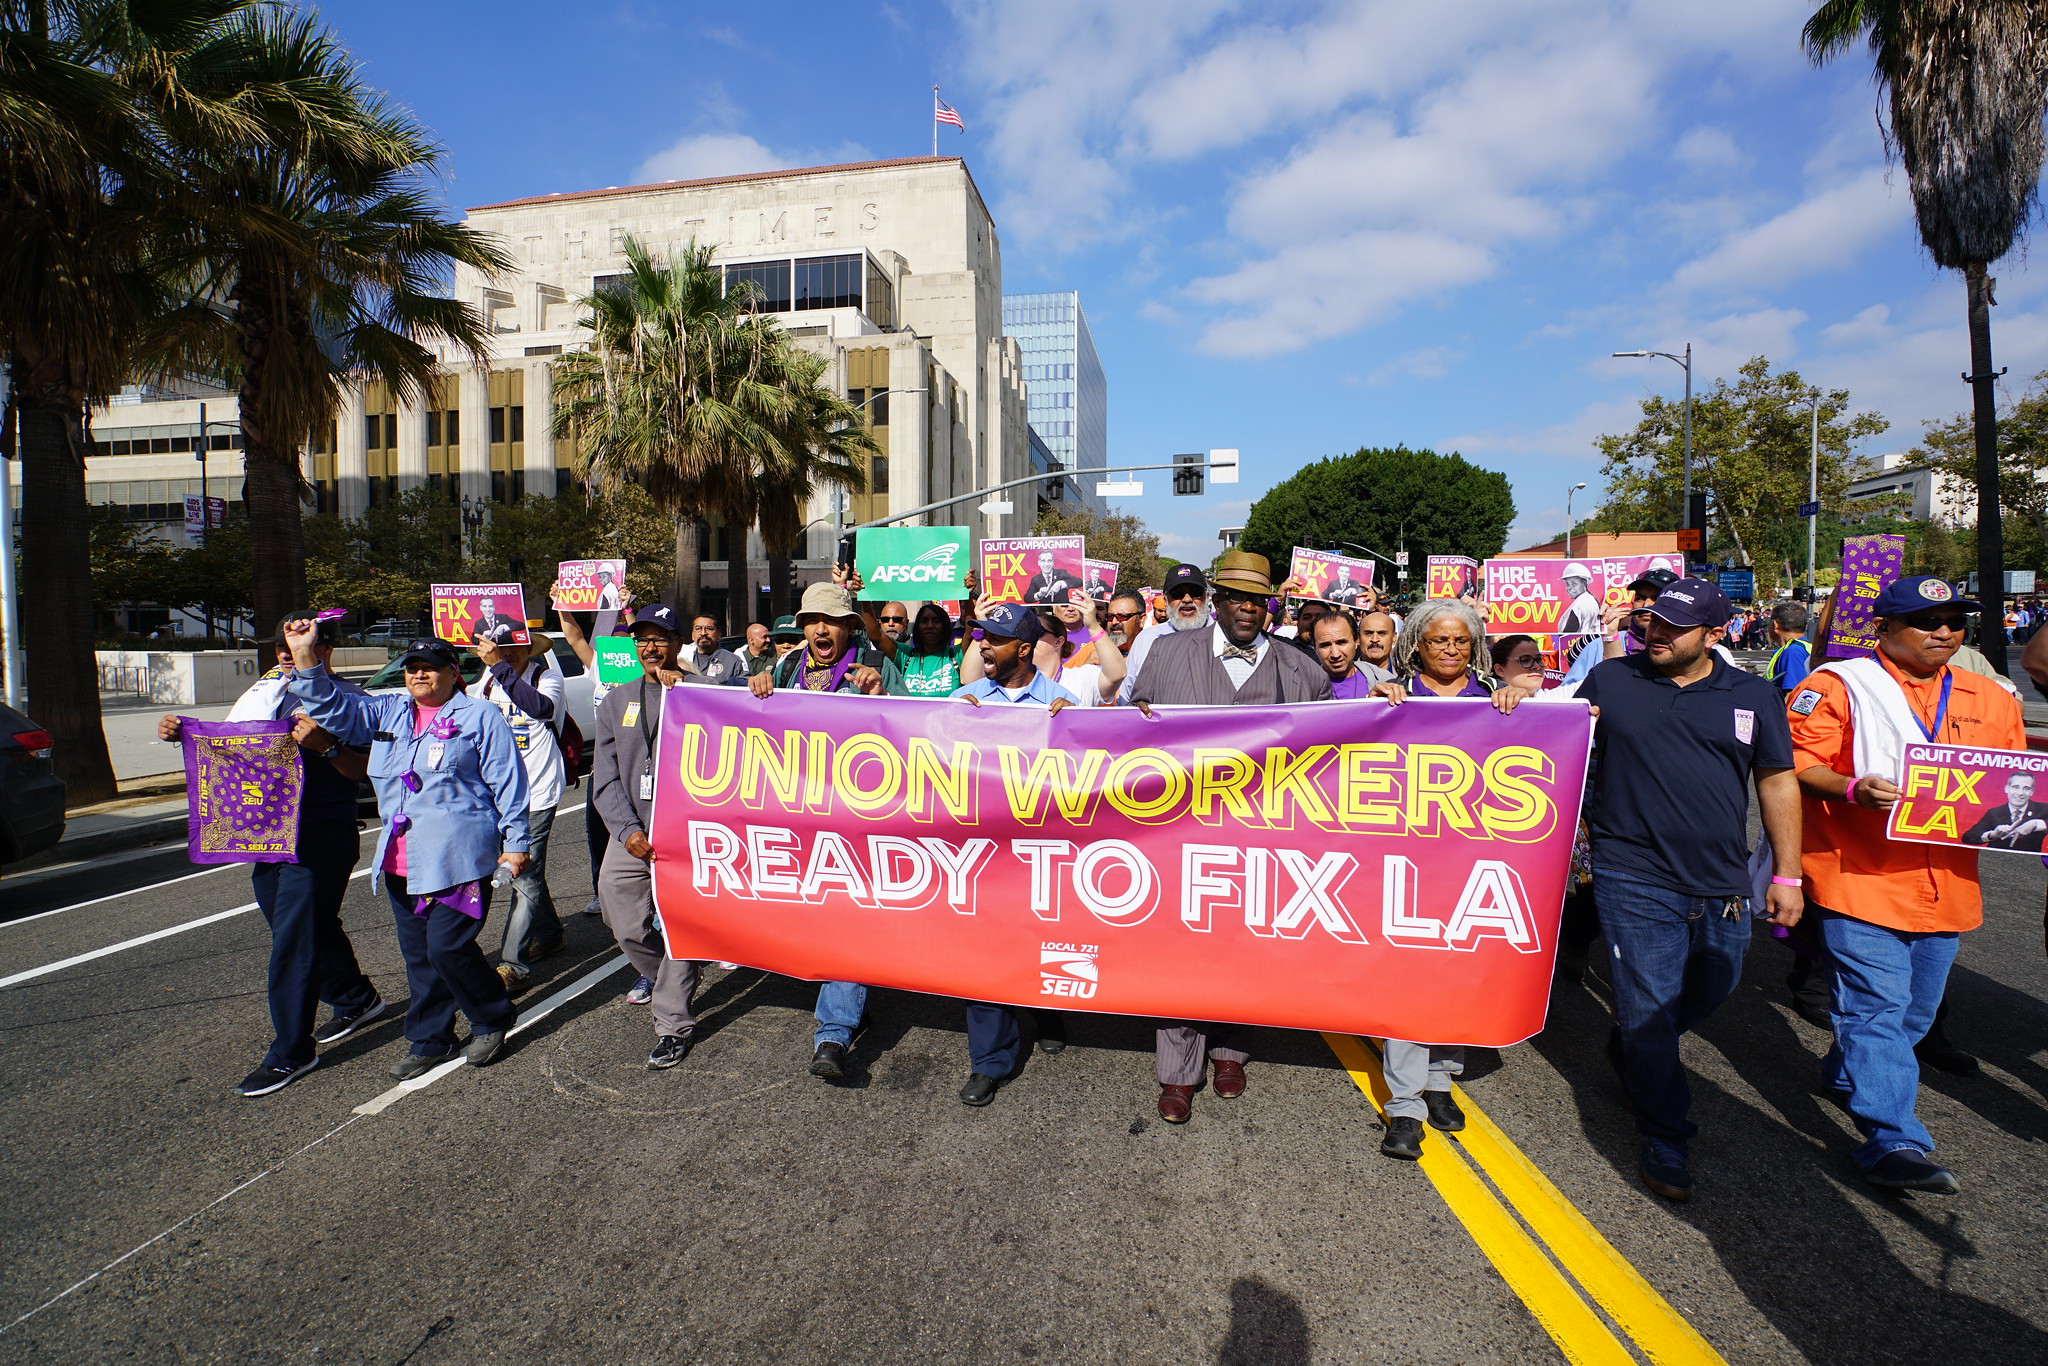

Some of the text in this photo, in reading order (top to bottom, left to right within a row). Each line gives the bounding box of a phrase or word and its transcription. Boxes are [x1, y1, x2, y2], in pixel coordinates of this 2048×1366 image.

[523, 203, 880, 264] THE TIMES
[984, 539, 1080, 552] QUIT CAMPAIGNING
[984, 553, 1028, 577] FIX
[1084, 561, 1117, 571] MPAIGNING
[1293, 557, 1329, 579] FIX
[1296, 550, 1371, 569] QUIT CAMPAIGNING
[559, 565, 583, 577] HIRE
[870, 565, 956, 582] AFSCME
[1430, 565, 1461, 581] FIX
[1489, 566, 1537, 583] HIRE
[1605, 562, 1627, 575] RE
[435, 586, 518, 596] QUIT CAMPAIGNING
[558, 577, 596, 589] LOCAL
[986, 579, 1022, 602] LA
[1291, 576, 1320, 596] LA
[1429, 582, 1456, 598] LA
[557, 588, 598, 604] NOW
[1489, 584, 1558, 601] LOCAL
[1853, 588, 1881, 599] SEIU
[435, 598, 472, 620] FIX
[1488, 601, 1562, 623] NOW
[436, 622, 470, 642] LA
[1840, 635, 1876, 647] SEIU 72
[602, 652, 631, 661] NEVER
[614, 660, 637, 668] QUIT
[233, 659, 255, 676] 10
[905, 676, 952, 689] AFSCME
[1909, 747, 1955, 763] QUIT
[680, 723, 1558, 843] UNION WORKERS
[1906, 764, 1987, 804] FIX
[241, 797, 264, 805] SEIU
[1895, 801, 1958, 838] LA
[688, 820, 1541, 954] READY TO FIX LA
[1041, 941, 1098, 953] LOCAL 721
[1040, 979, 1098, 999] SEIU
